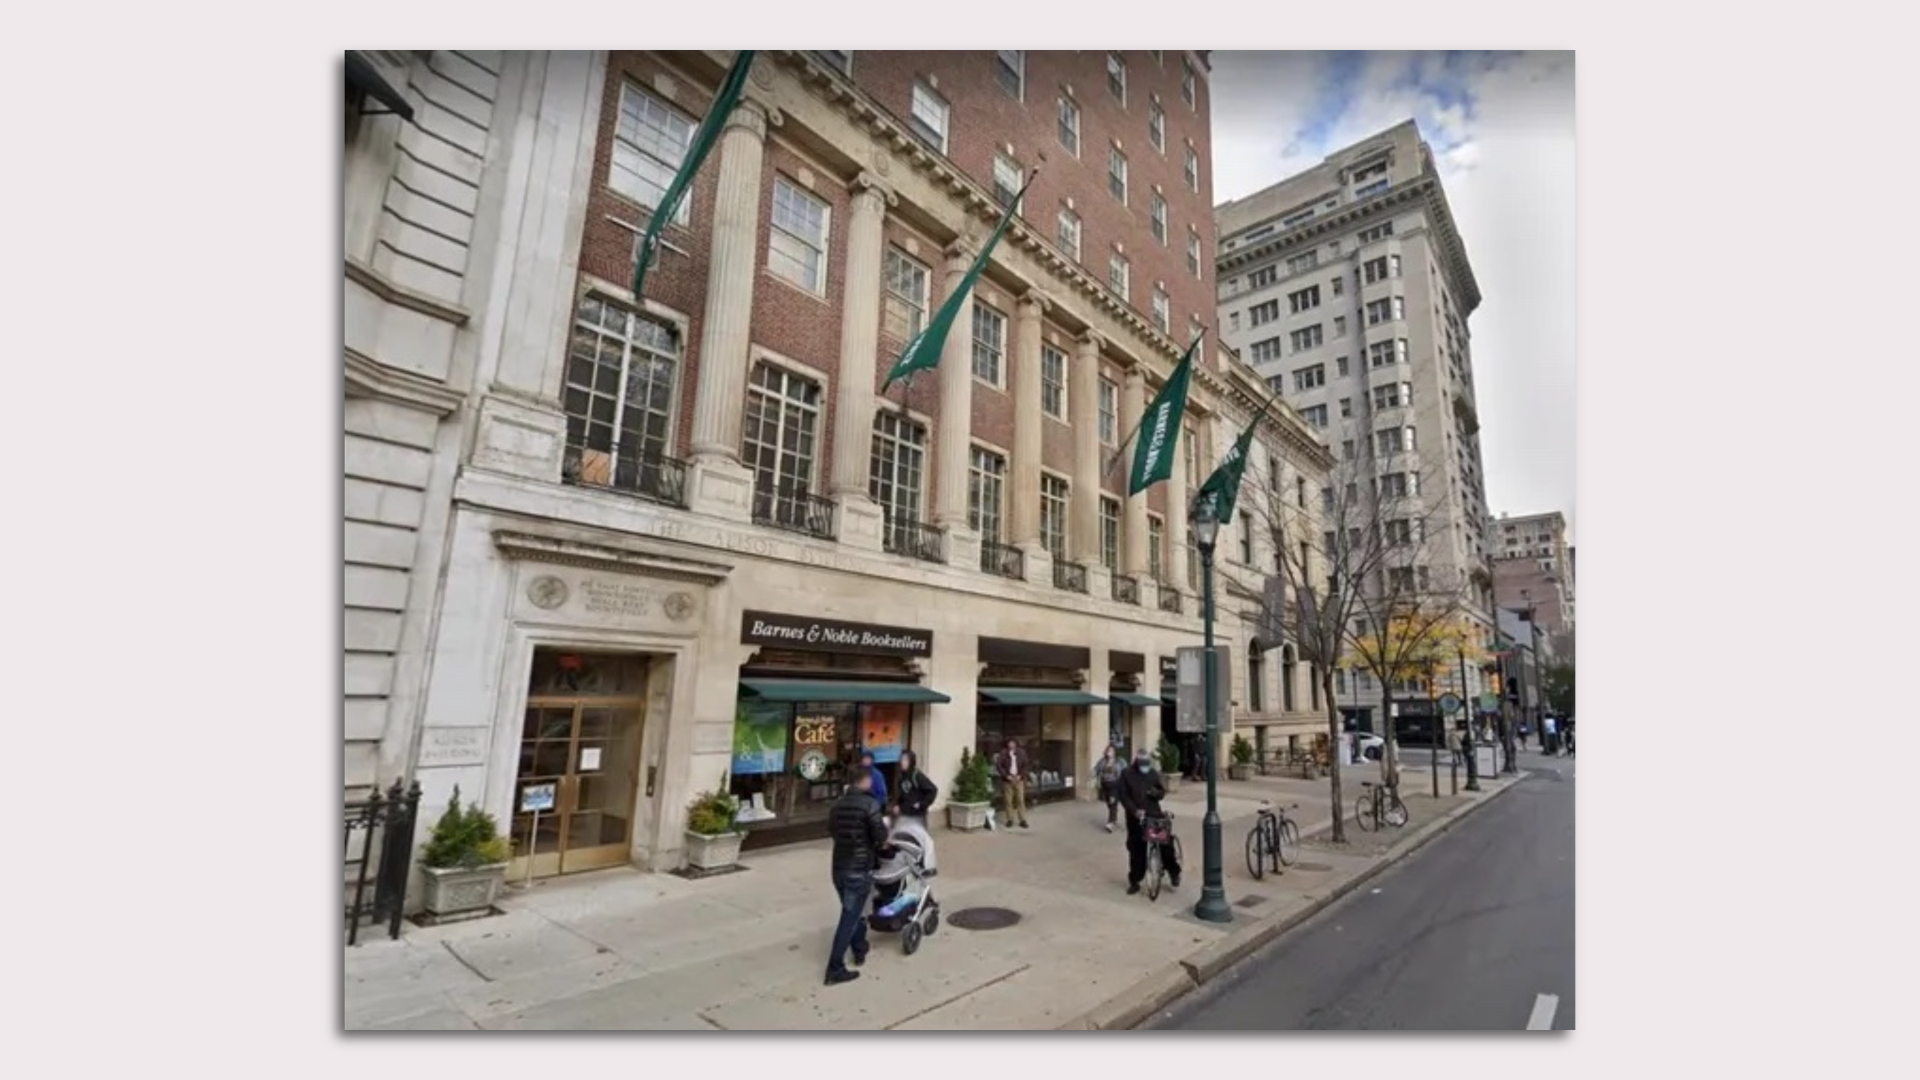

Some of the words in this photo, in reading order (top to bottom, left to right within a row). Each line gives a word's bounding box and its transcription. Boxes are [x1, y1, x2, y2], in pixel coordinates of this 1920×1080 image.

[751, 620, 805, 640] Barnes
[806, 624, 820, 643] &
[821, 627, 859, 645] Noble
[861, 631, 928, 650] Booksellers
[794, 723, 836, 744] Café
